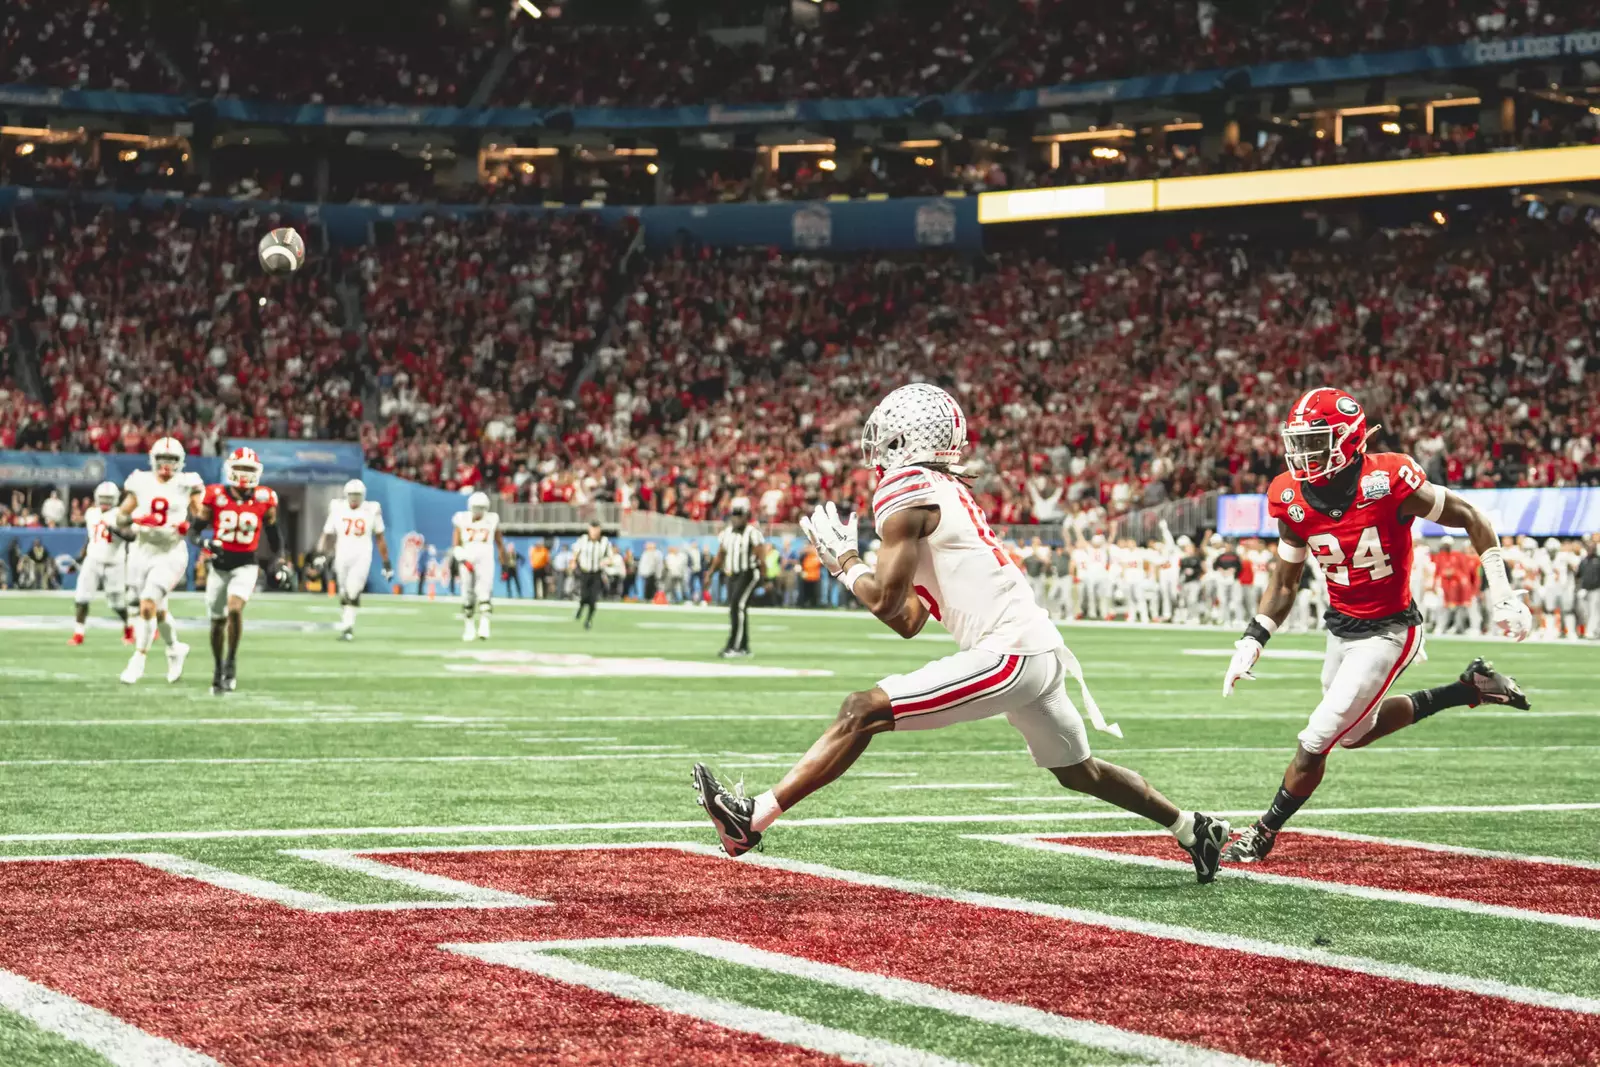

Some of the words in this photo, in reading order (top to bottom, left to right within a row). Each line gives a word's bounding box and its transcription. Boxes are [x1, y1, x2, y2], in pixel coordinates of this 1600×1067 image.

[151, 497, 168, 526] 8
[342, 518, 366, 537] 79
[466, 528, 489, 542] 77
[1307, 526, 1394, 586] 24
